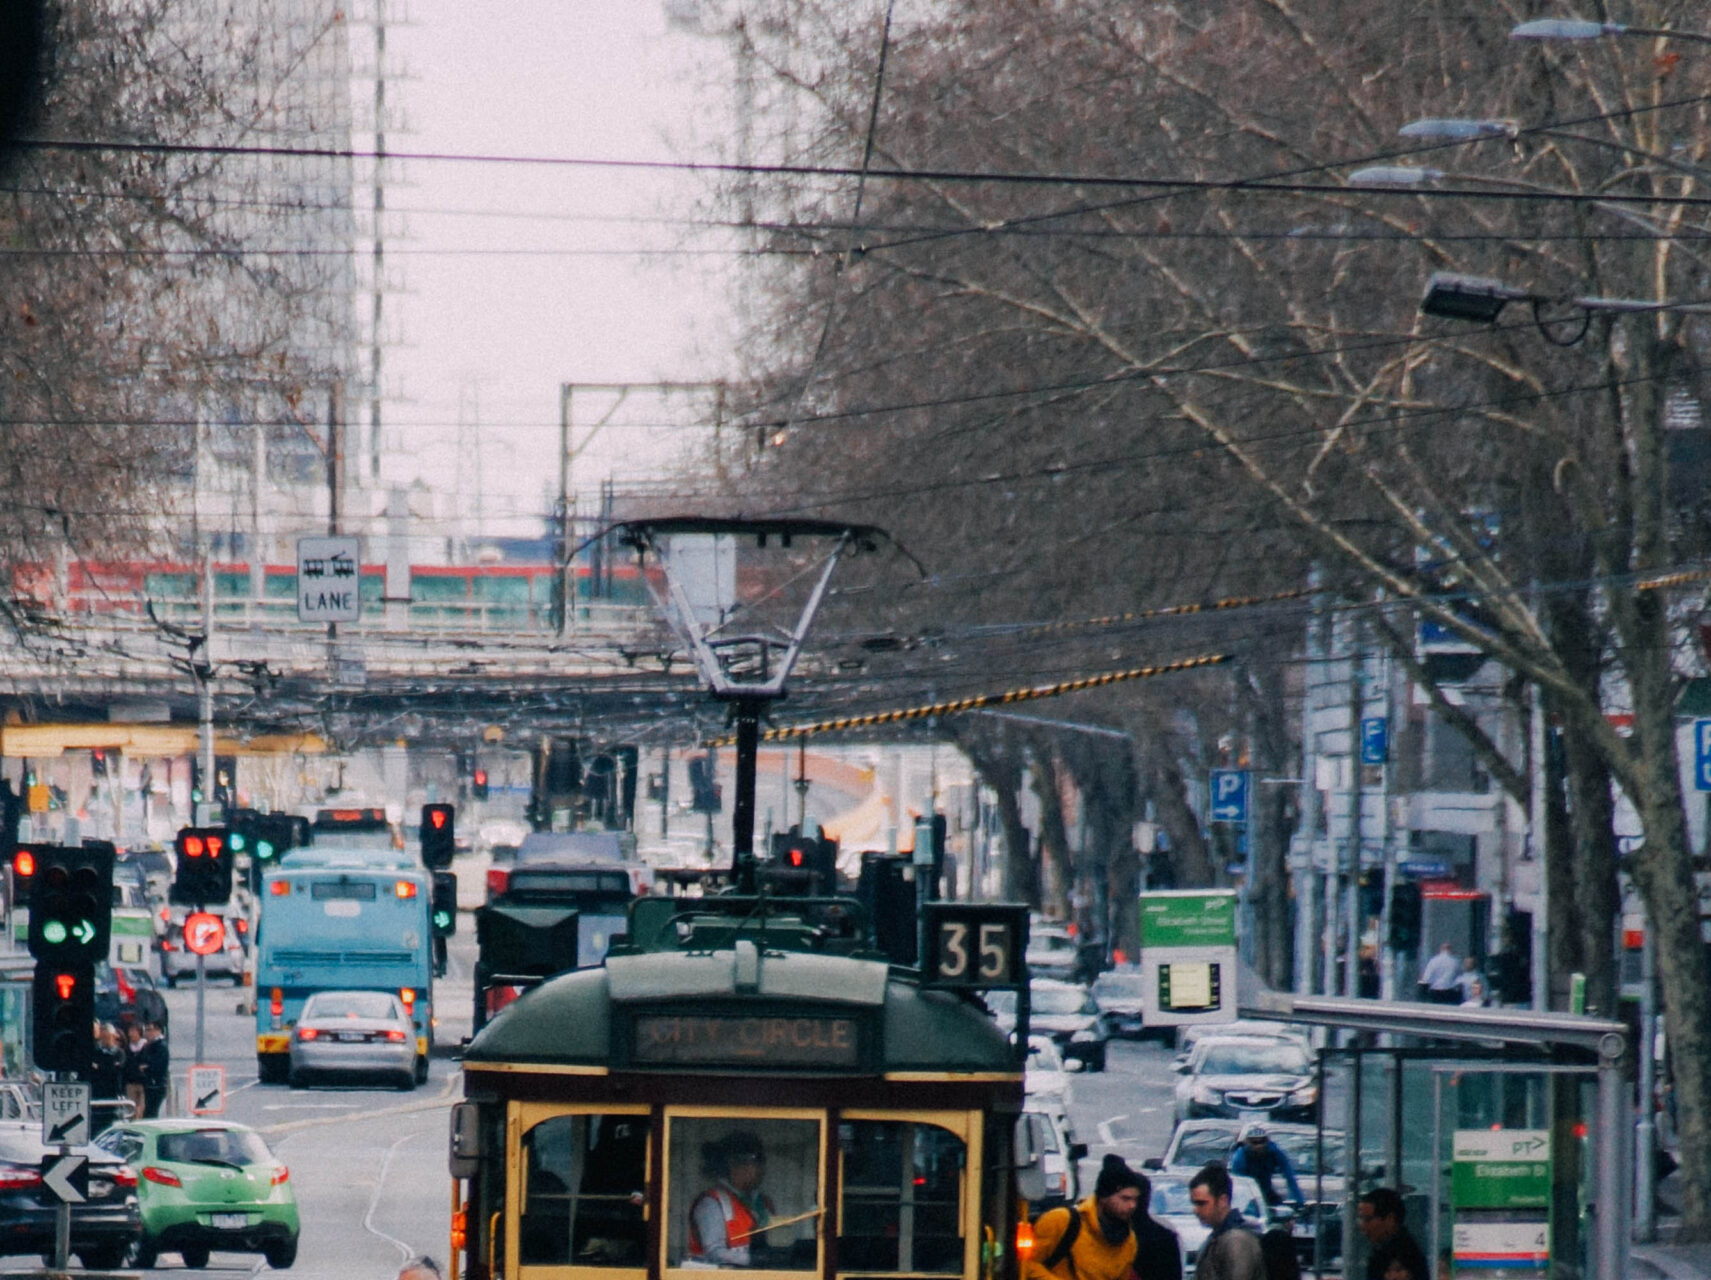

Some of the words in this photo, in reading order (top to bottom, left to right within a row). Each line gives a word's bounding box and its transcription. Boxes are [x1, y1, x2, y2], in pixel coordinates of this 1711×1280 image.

[304, 592, 352, 610] LANE
[1218, 774, 1242, 801] P
[940, 922, 1004, 978] 35
[739, 1017, 850, 1049] CIRCLE
[51, 1087, 82, 1098] KEEP
[52, 1101, 80, 1110] LEFT
